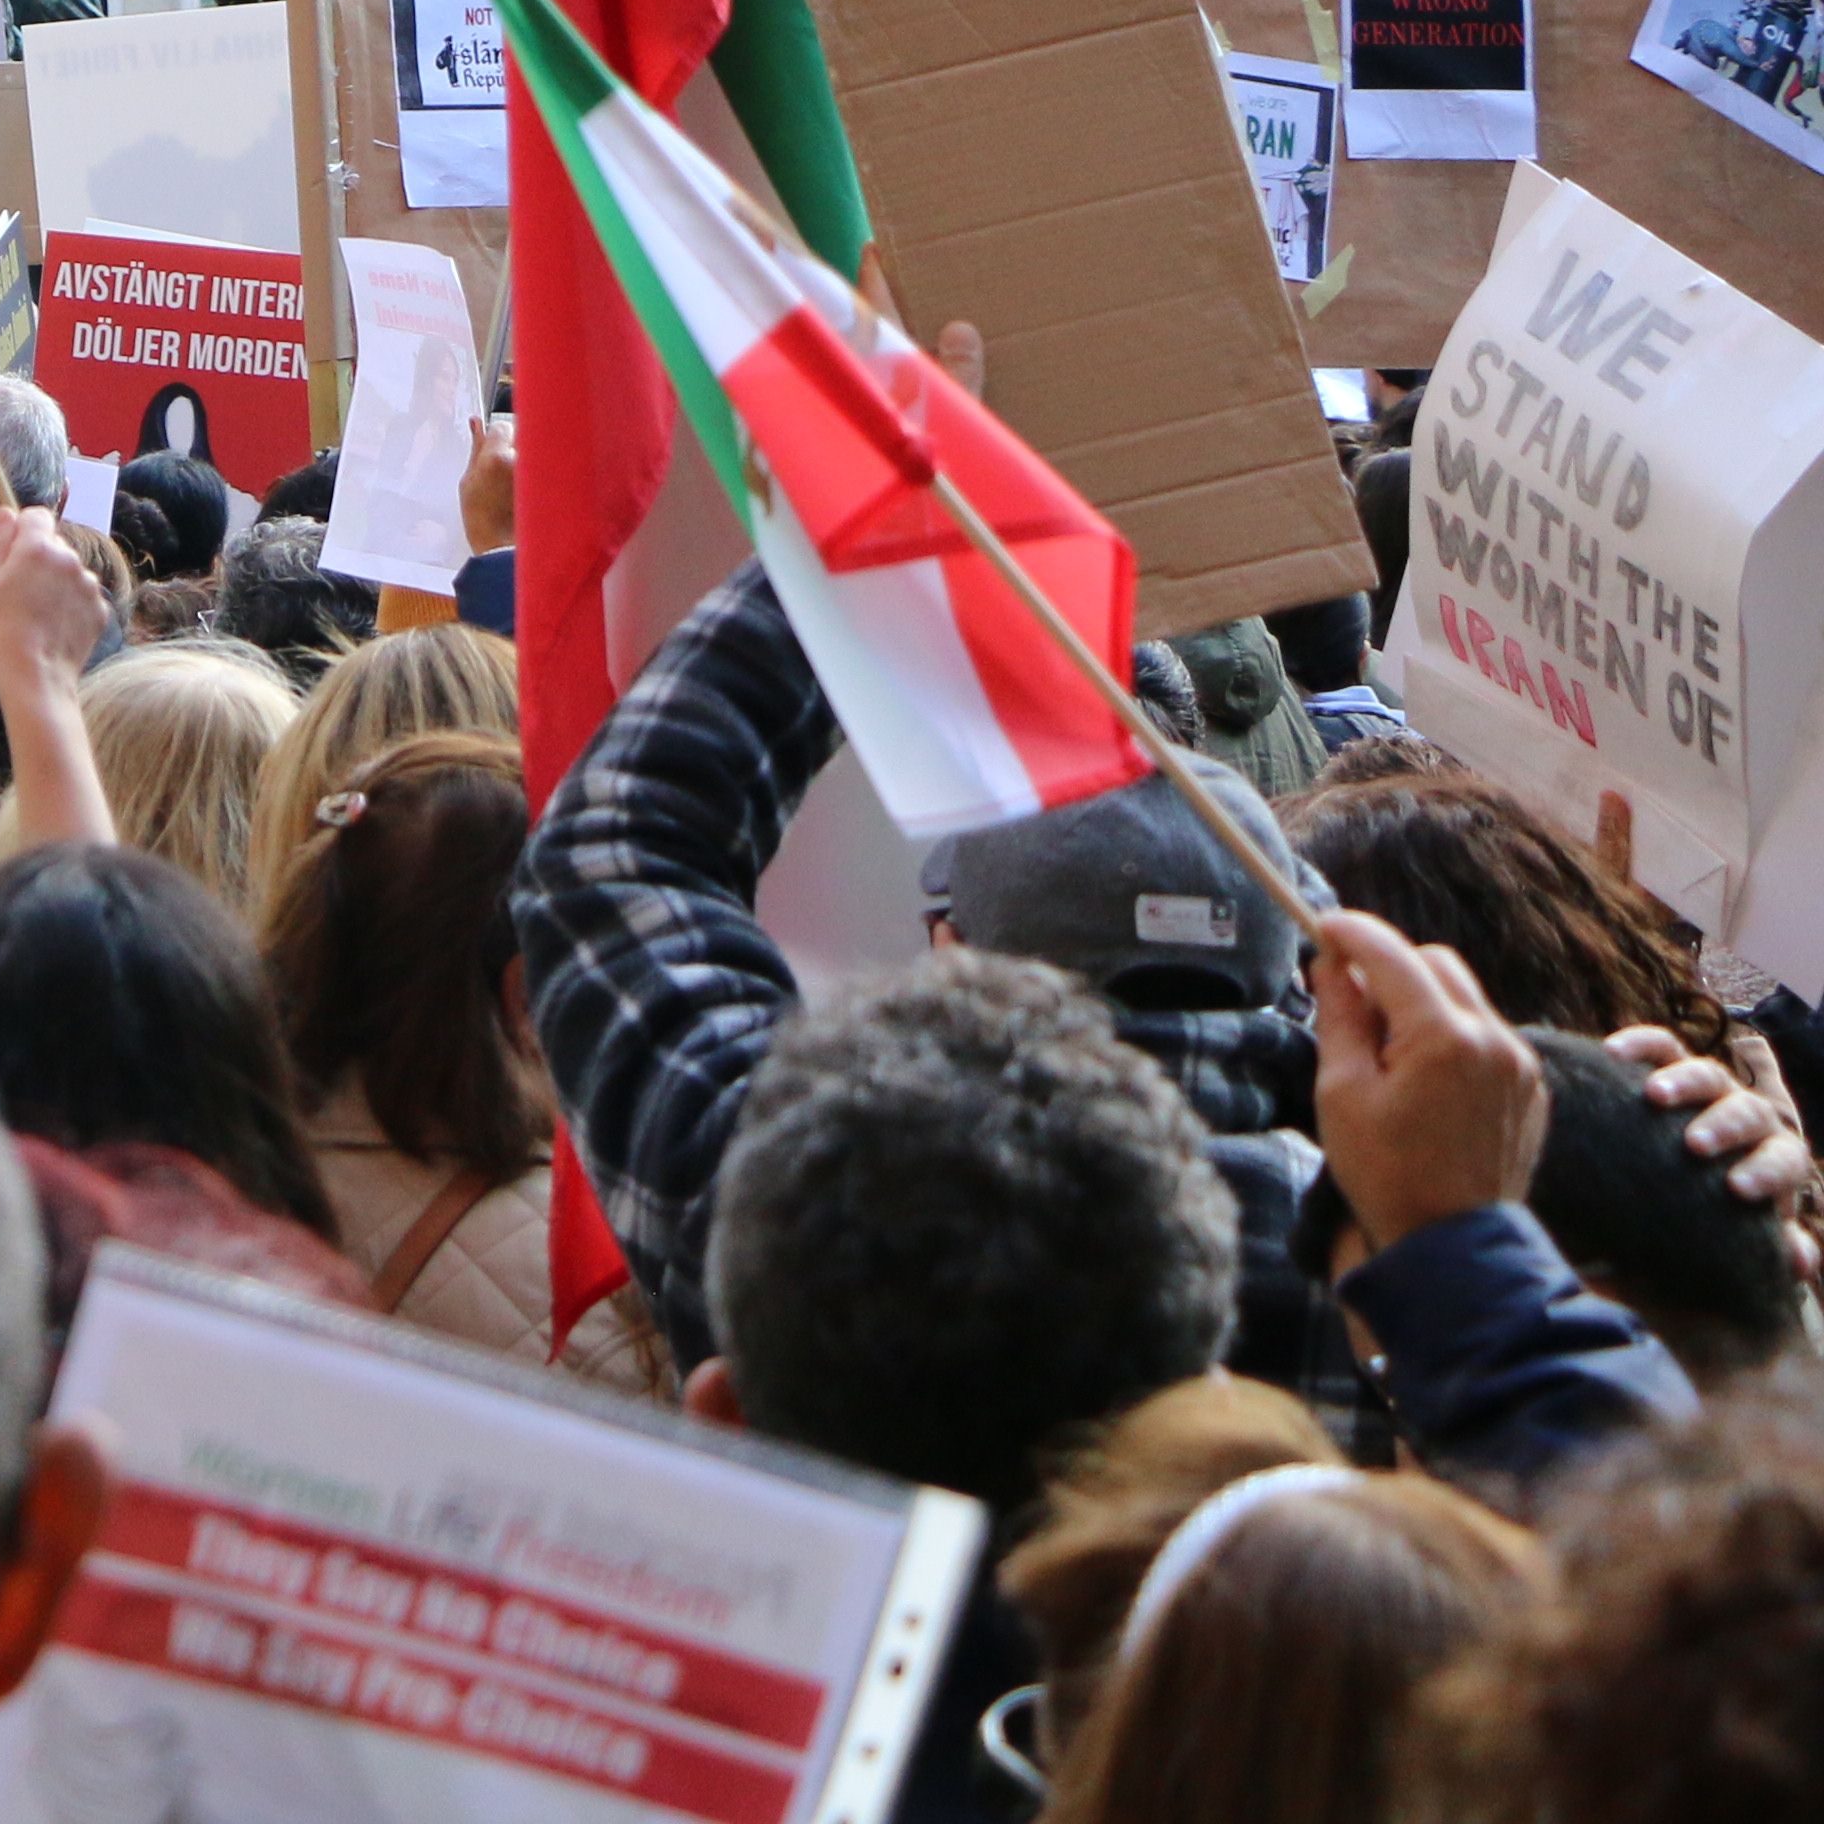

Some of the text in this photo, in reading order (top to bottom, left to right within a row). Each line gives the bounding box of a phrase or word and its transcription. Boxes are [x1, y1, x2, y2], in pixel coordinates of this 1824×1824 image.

[465, 7, 492, 26] NOT
[1353, 20, 1524, 47] GENERATION
[1763, 25, 1794, 52] OIL
[1247, 115, 1296, 160] RAN
[53, 261, 204, 311] AVSTÄNGT
[1524, 247, 1695, 404] WE
[72, 317, 181, 368] DÖLJER
[1450, 338, 1652, 534] STAND
[1434, 418, 1720, 683] WITH THE
[1424, 494, 1734, 766] WOMEN OF
[1438, 593, 1598, 750] IRAN
[190, 1512, 683, 1704] They Say No Choice
[260, 1624, 358, 1703] Say
